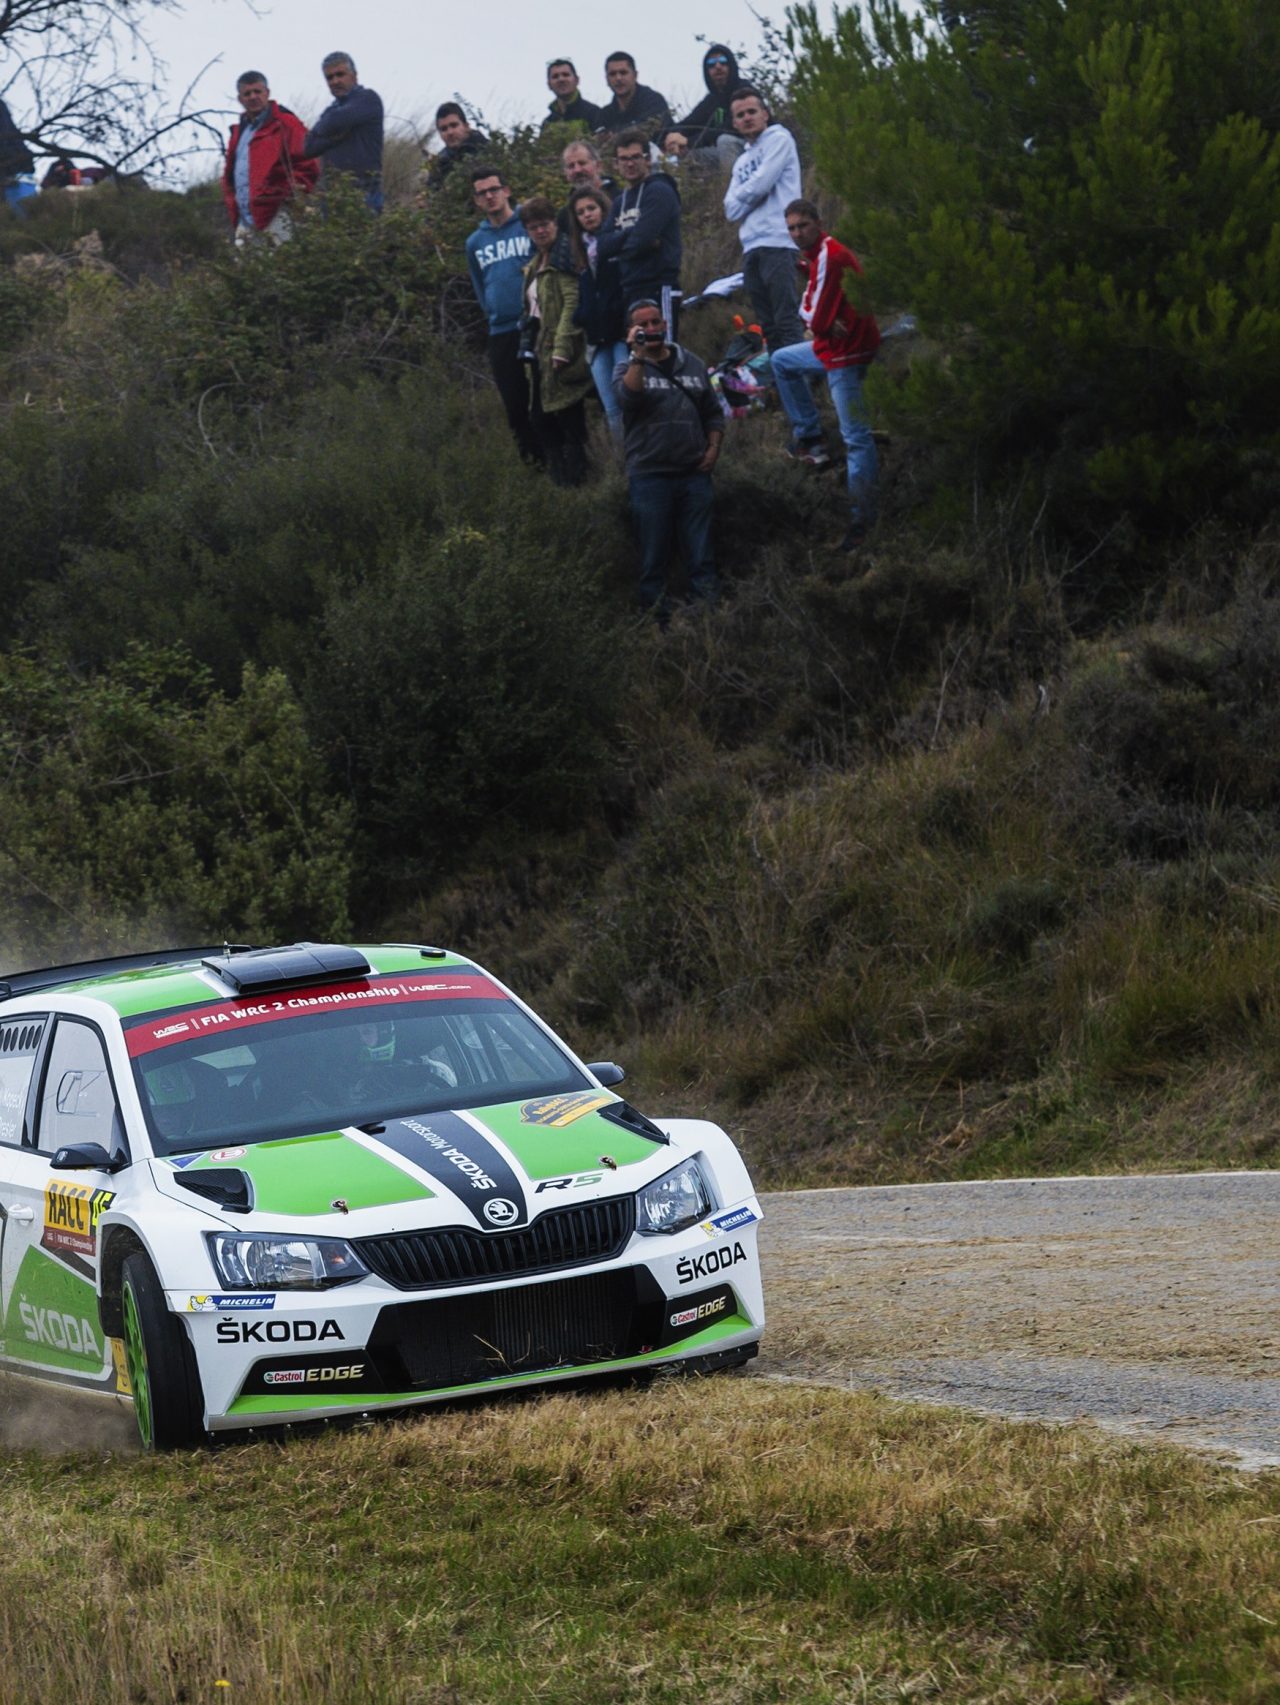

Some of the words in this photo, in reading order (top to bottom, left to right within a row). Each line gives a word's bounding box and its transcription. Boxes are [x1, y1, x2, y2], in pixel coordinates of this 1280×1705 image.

[200, 1013, 230, 1026] FIA
[231, 1005, 270, 1019] WRC
[272, 1001, 285, 1011] 2
[288, 986, 400, 1008] Championship
[400, 1120, 453, 1150] Motorsport
[442, 1148, 498, 1190] ŠKODA
[534, 1172, 604, 1194] R5
[48, 1183, 87, 1230] RACC
[720, 1210, 753, 1227] MICHELIN
[676, 1241, 748, 1285] ŠKODA
[219, 1297, 275, 1307] MICHELIN
[677, 1312, 696, 1324] Castrol
[698, 1296, 727, 1319] EDGE
[18, 1292, 102, 1359] ŠKODA
[216, 1317, 346, 1344] ŠKODA
[274, 1371, 303, 1382] Castrol
[306, 1364, 366, 1382] EDGE
